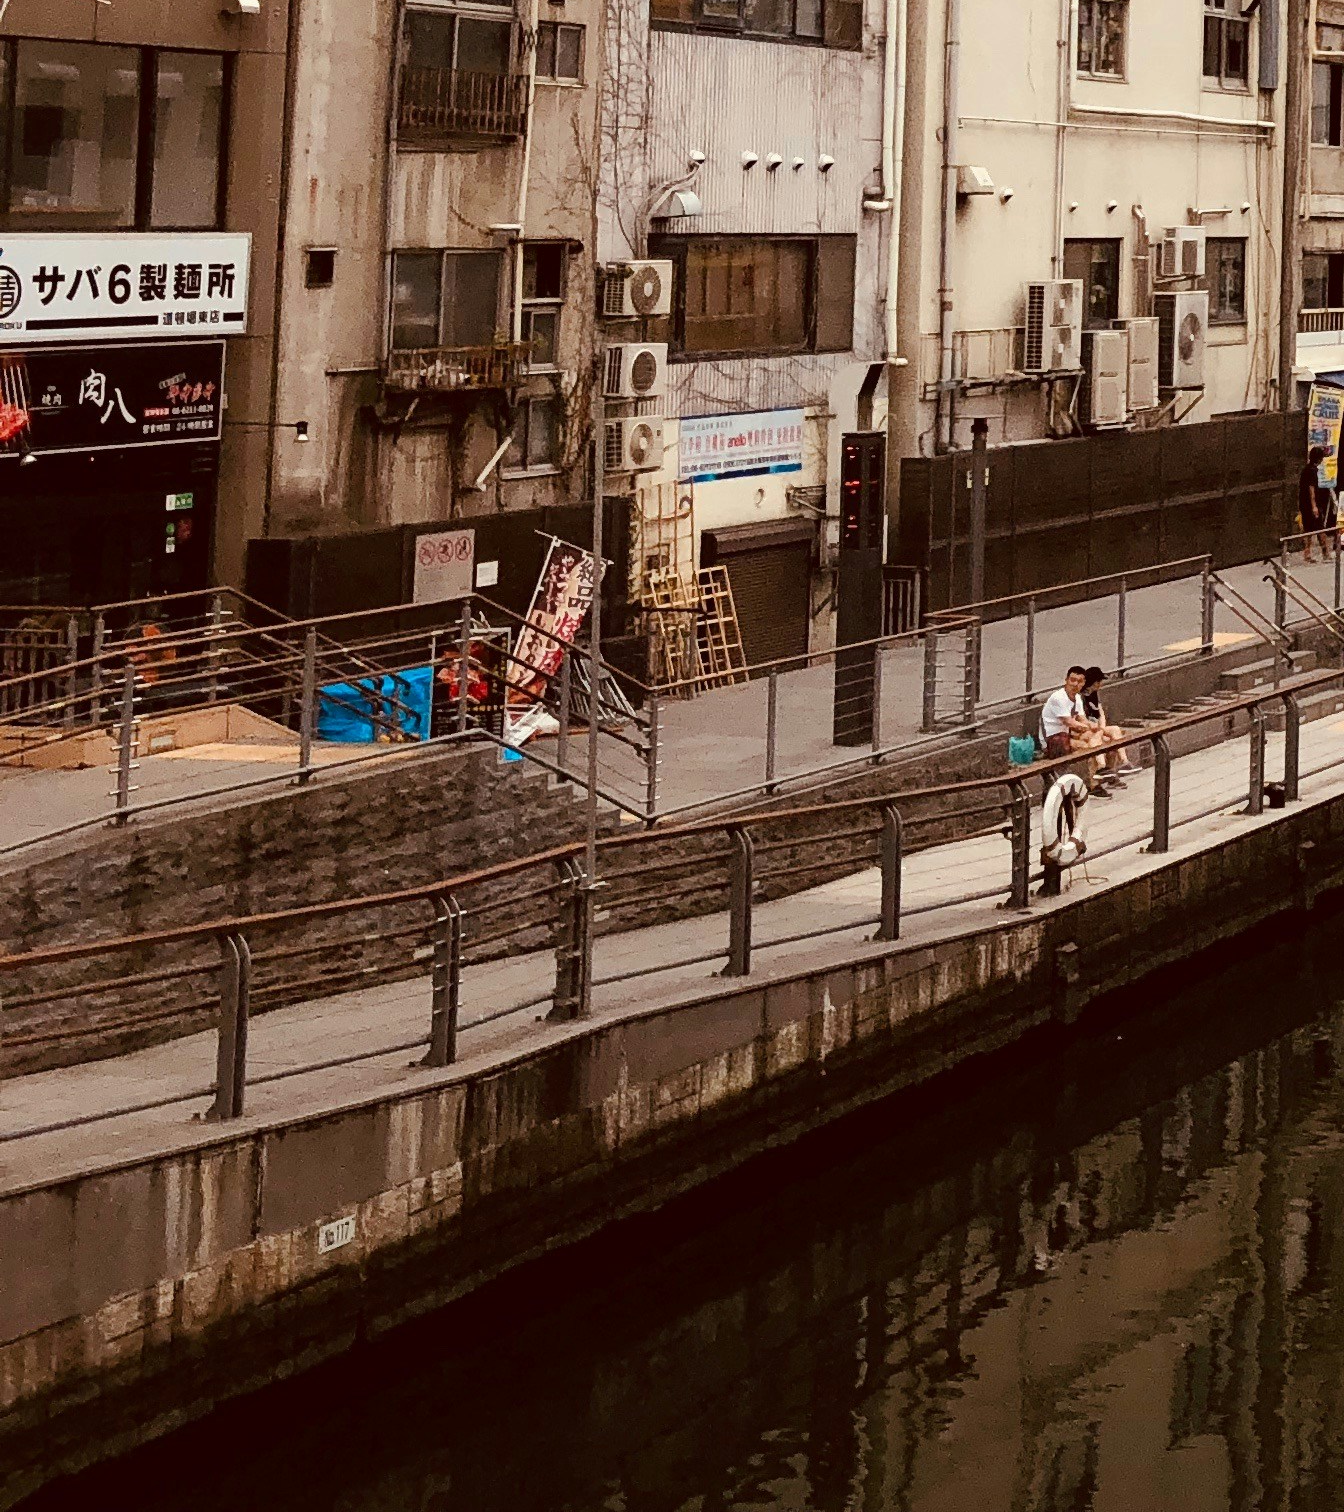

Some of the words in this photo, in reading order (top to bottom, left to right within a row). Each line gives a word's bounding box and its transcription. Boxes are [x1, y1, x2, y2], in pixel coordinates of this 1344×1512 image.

[32, 262, 236, 306] サバ6製麺所
